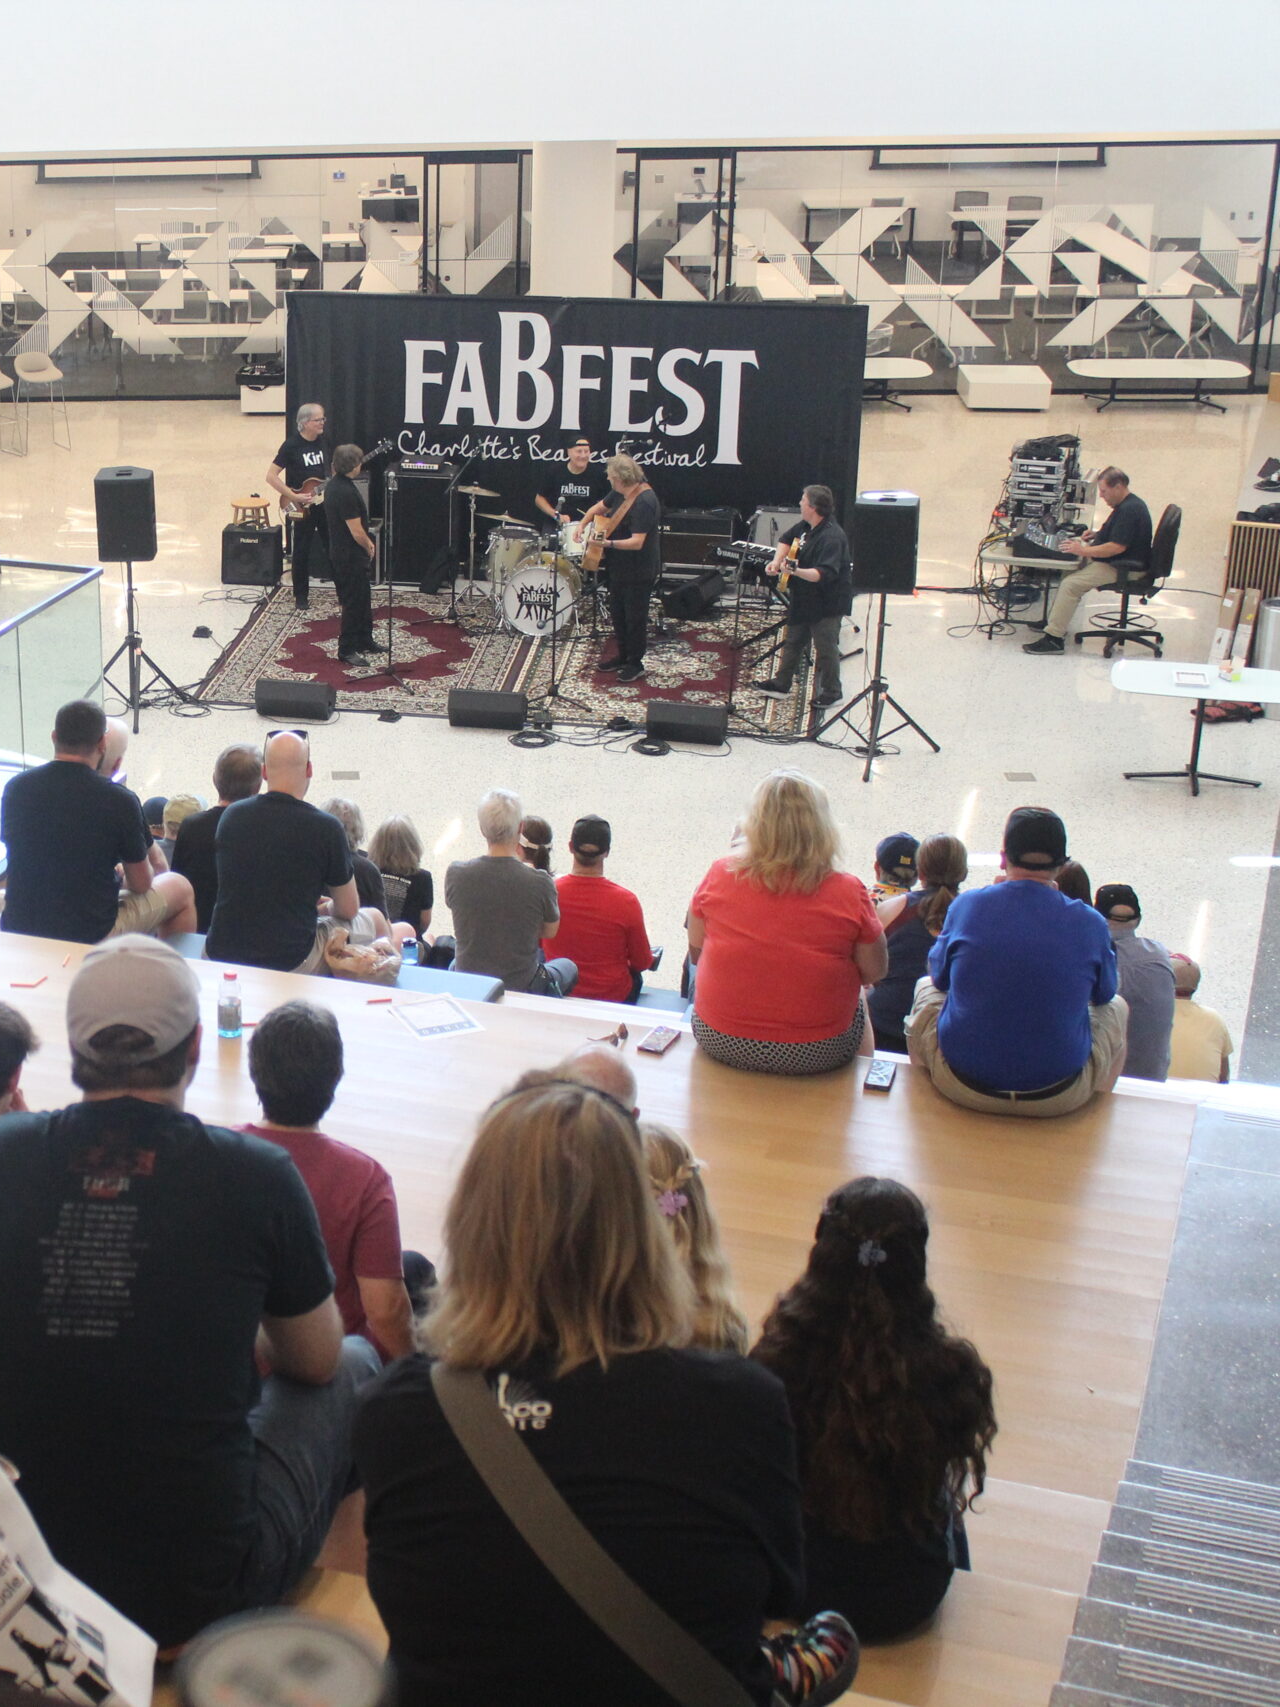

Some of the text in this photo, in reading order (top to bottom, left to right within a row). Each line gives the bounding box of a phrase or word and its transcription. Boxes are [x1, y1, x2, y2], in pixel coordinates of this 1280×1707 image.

[403, 311, 759, 465] FABFEST
[527, 434, 609, 463] Beaes
[560, 482, 590, 497] FABFEST
[722, 550, 740, 560] YAMAHA
[522, 589, 554, 606] FABFEST
